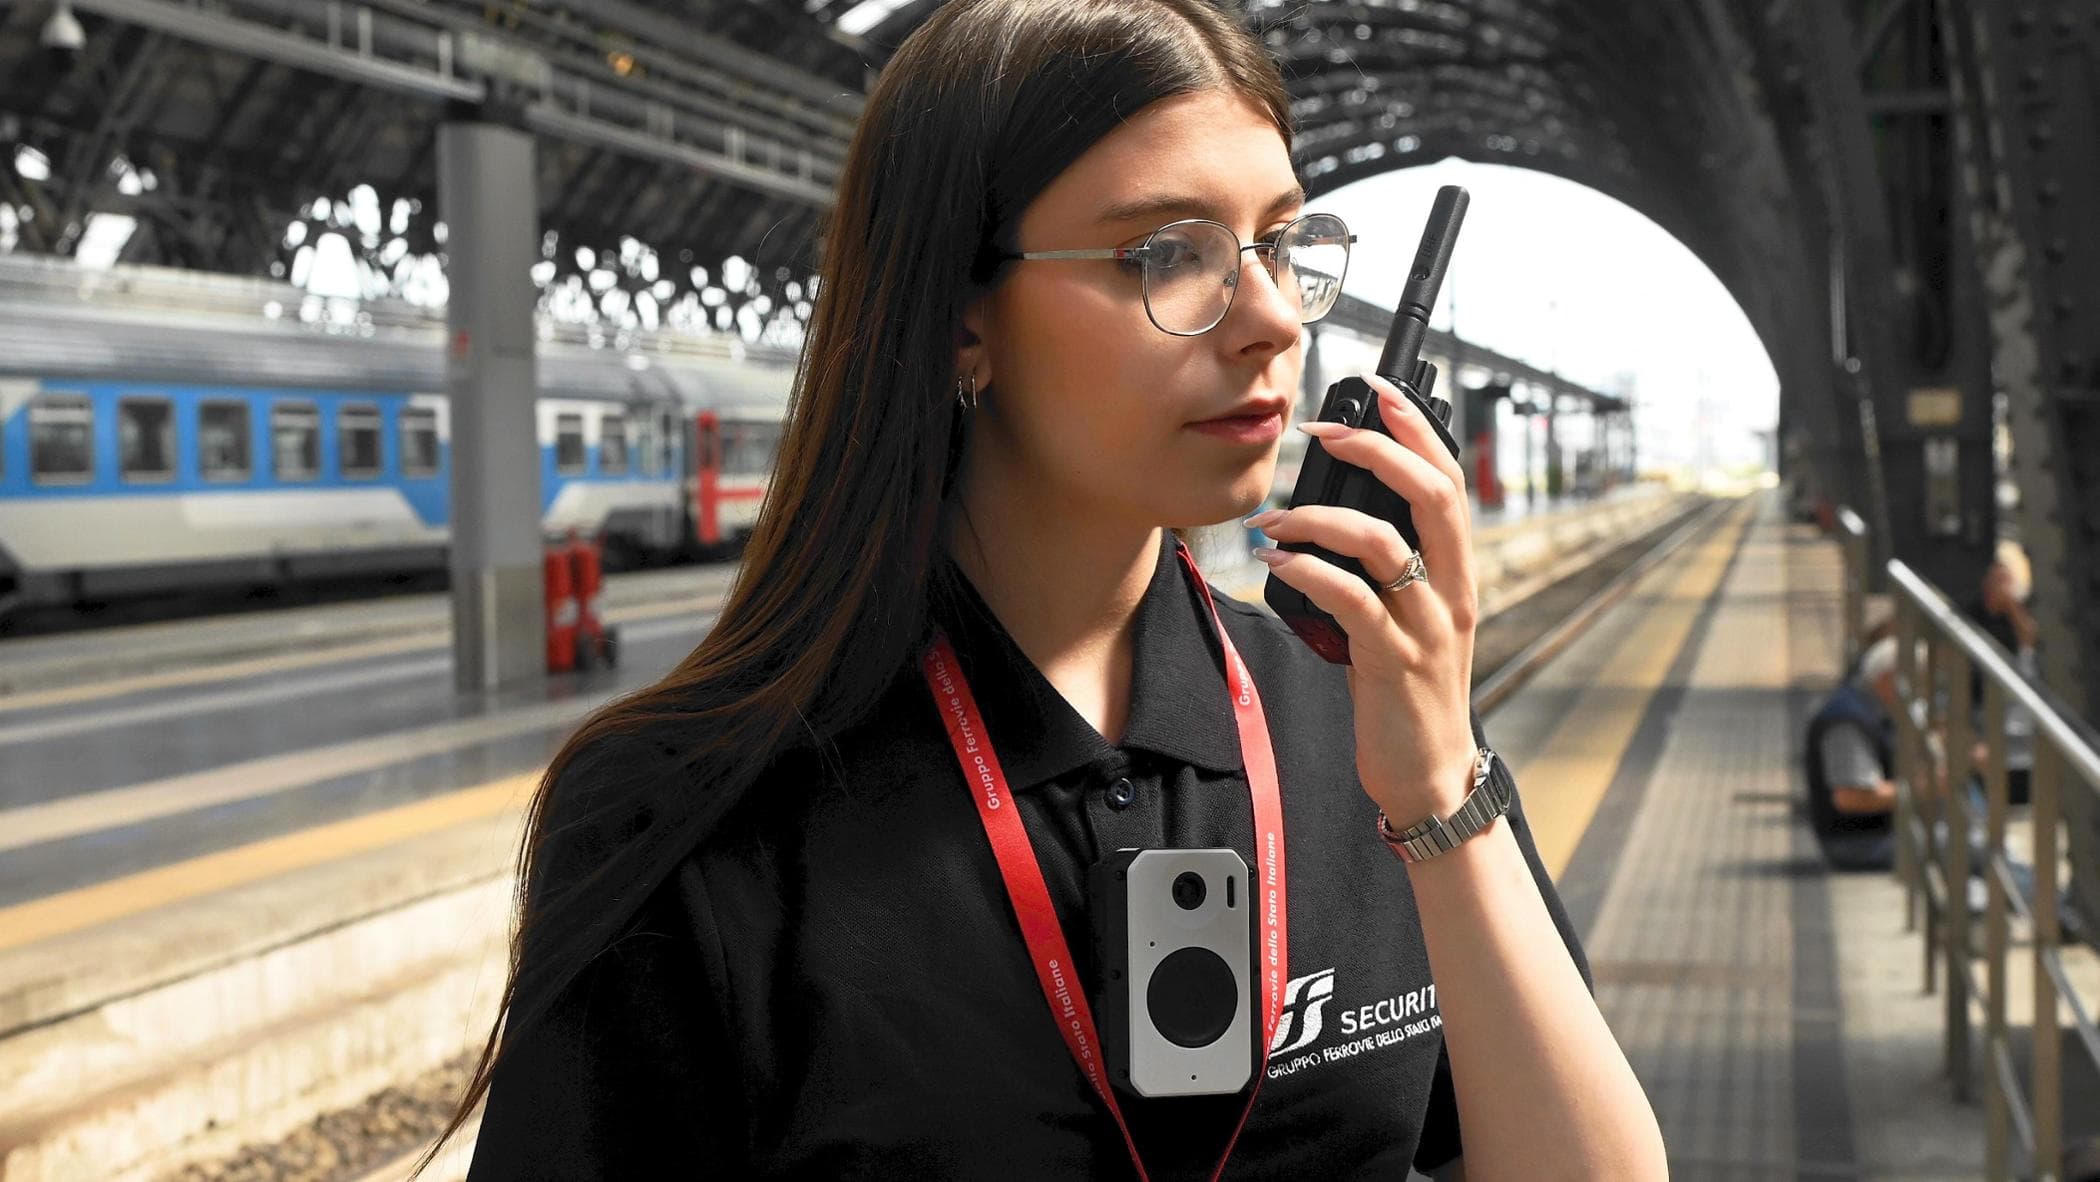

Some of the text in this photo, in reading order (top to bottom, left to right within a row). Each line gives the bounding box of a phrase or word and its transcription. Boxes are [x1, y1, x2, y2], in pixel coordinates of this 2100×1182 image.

[935, 663, 955, 695] dello
[950, 698, 979, 753] Ferrovie
[974, 755, 1001, 810] Gruppo
[1265, 831, 1278, 1032] Ferrovie dello Stato Italiane
[1048, 959, 1075, 1018] Italiane
[1071, 1020, 1091, 1059] Stato
[1267, 1052, 1321, 1079] GRUPPO
[1323, 1037, 1375, 1062] FERROVIE
[1376, 1028, 1405, 1047] DELLO
[1404, 1018, 1431, 1038] STATO
